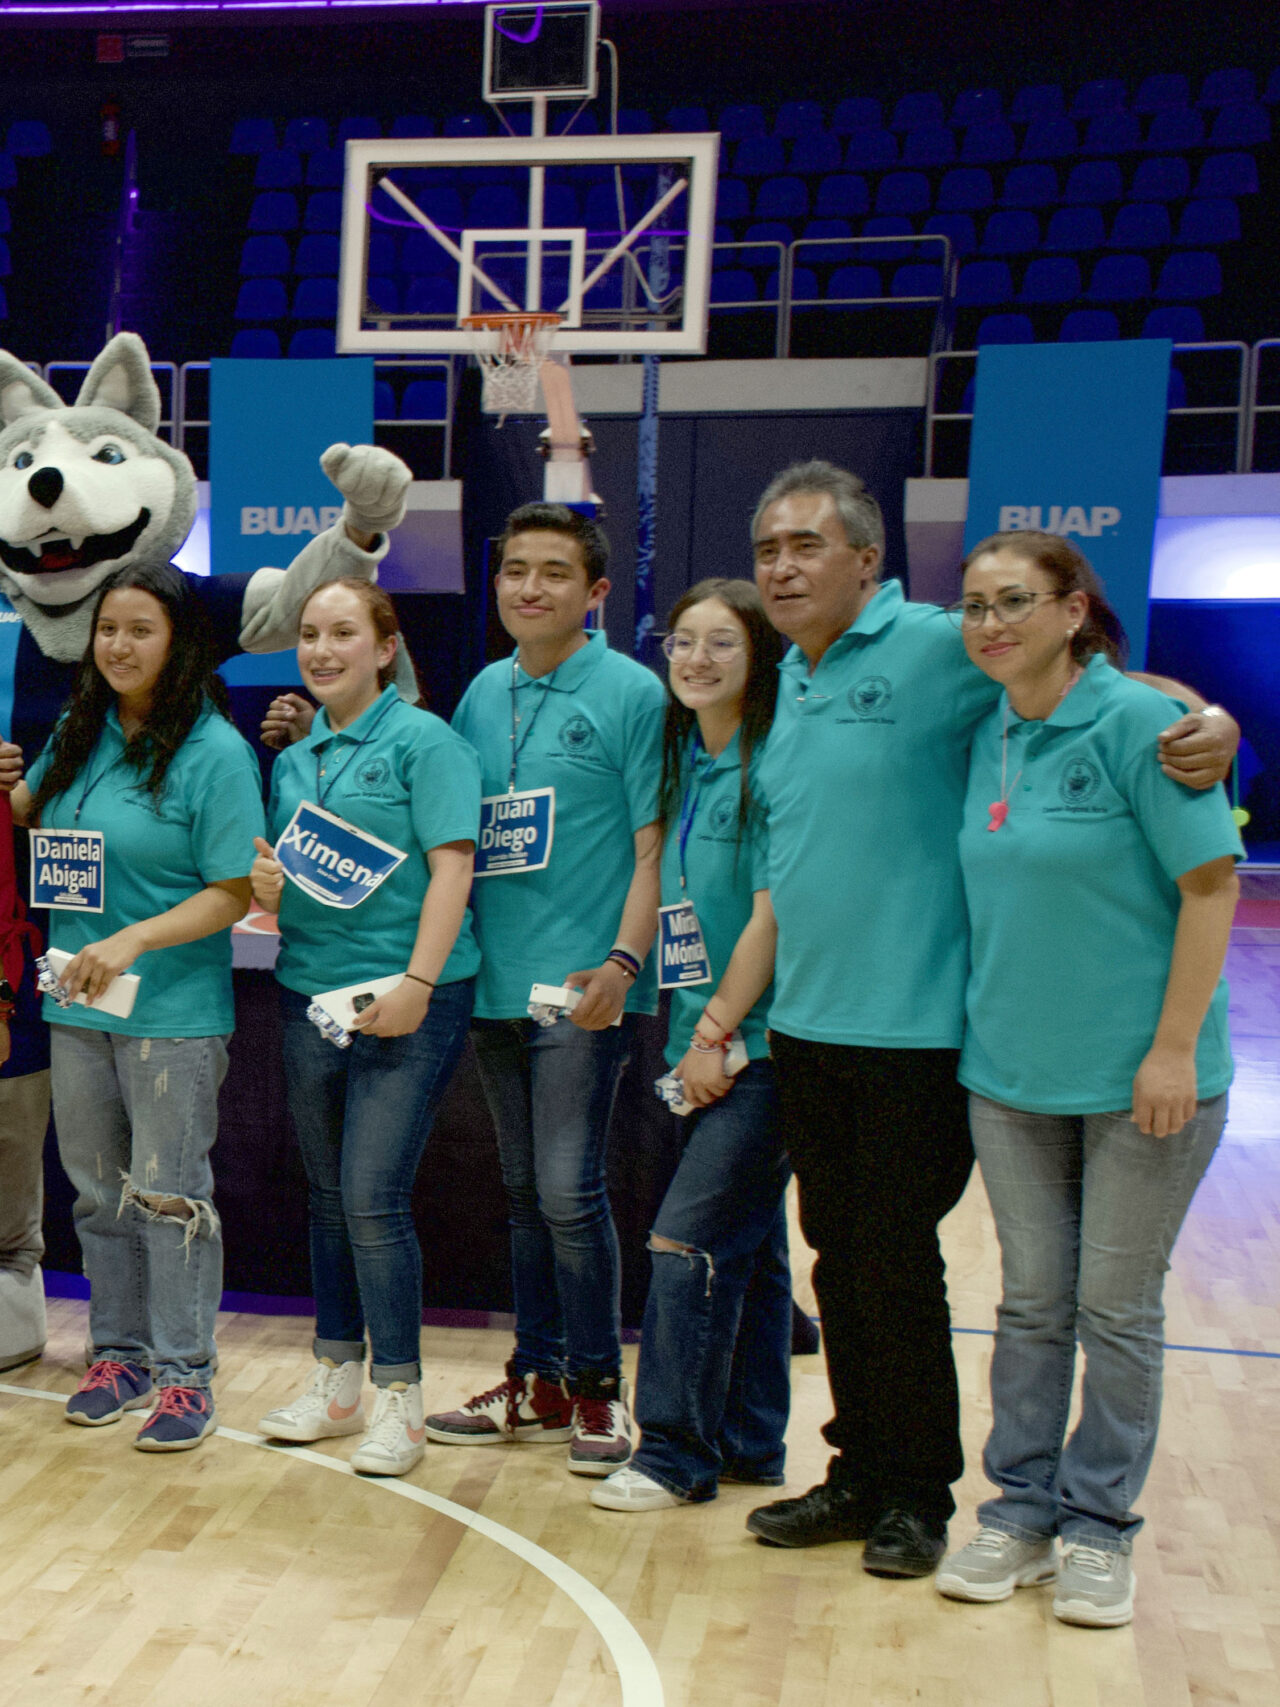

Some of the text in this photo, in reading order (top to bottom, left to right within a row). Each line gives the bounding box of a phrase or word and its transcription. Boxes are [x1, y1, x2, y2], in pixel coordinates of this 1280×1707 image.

[487, 798, 536, 828] Juan
[36, 836, 101, 861] Daniela
[481, 825, 538, 852] Diego
[282, 823, 384, 887] Ximena
[38, 863, 97, 894] Abigail
